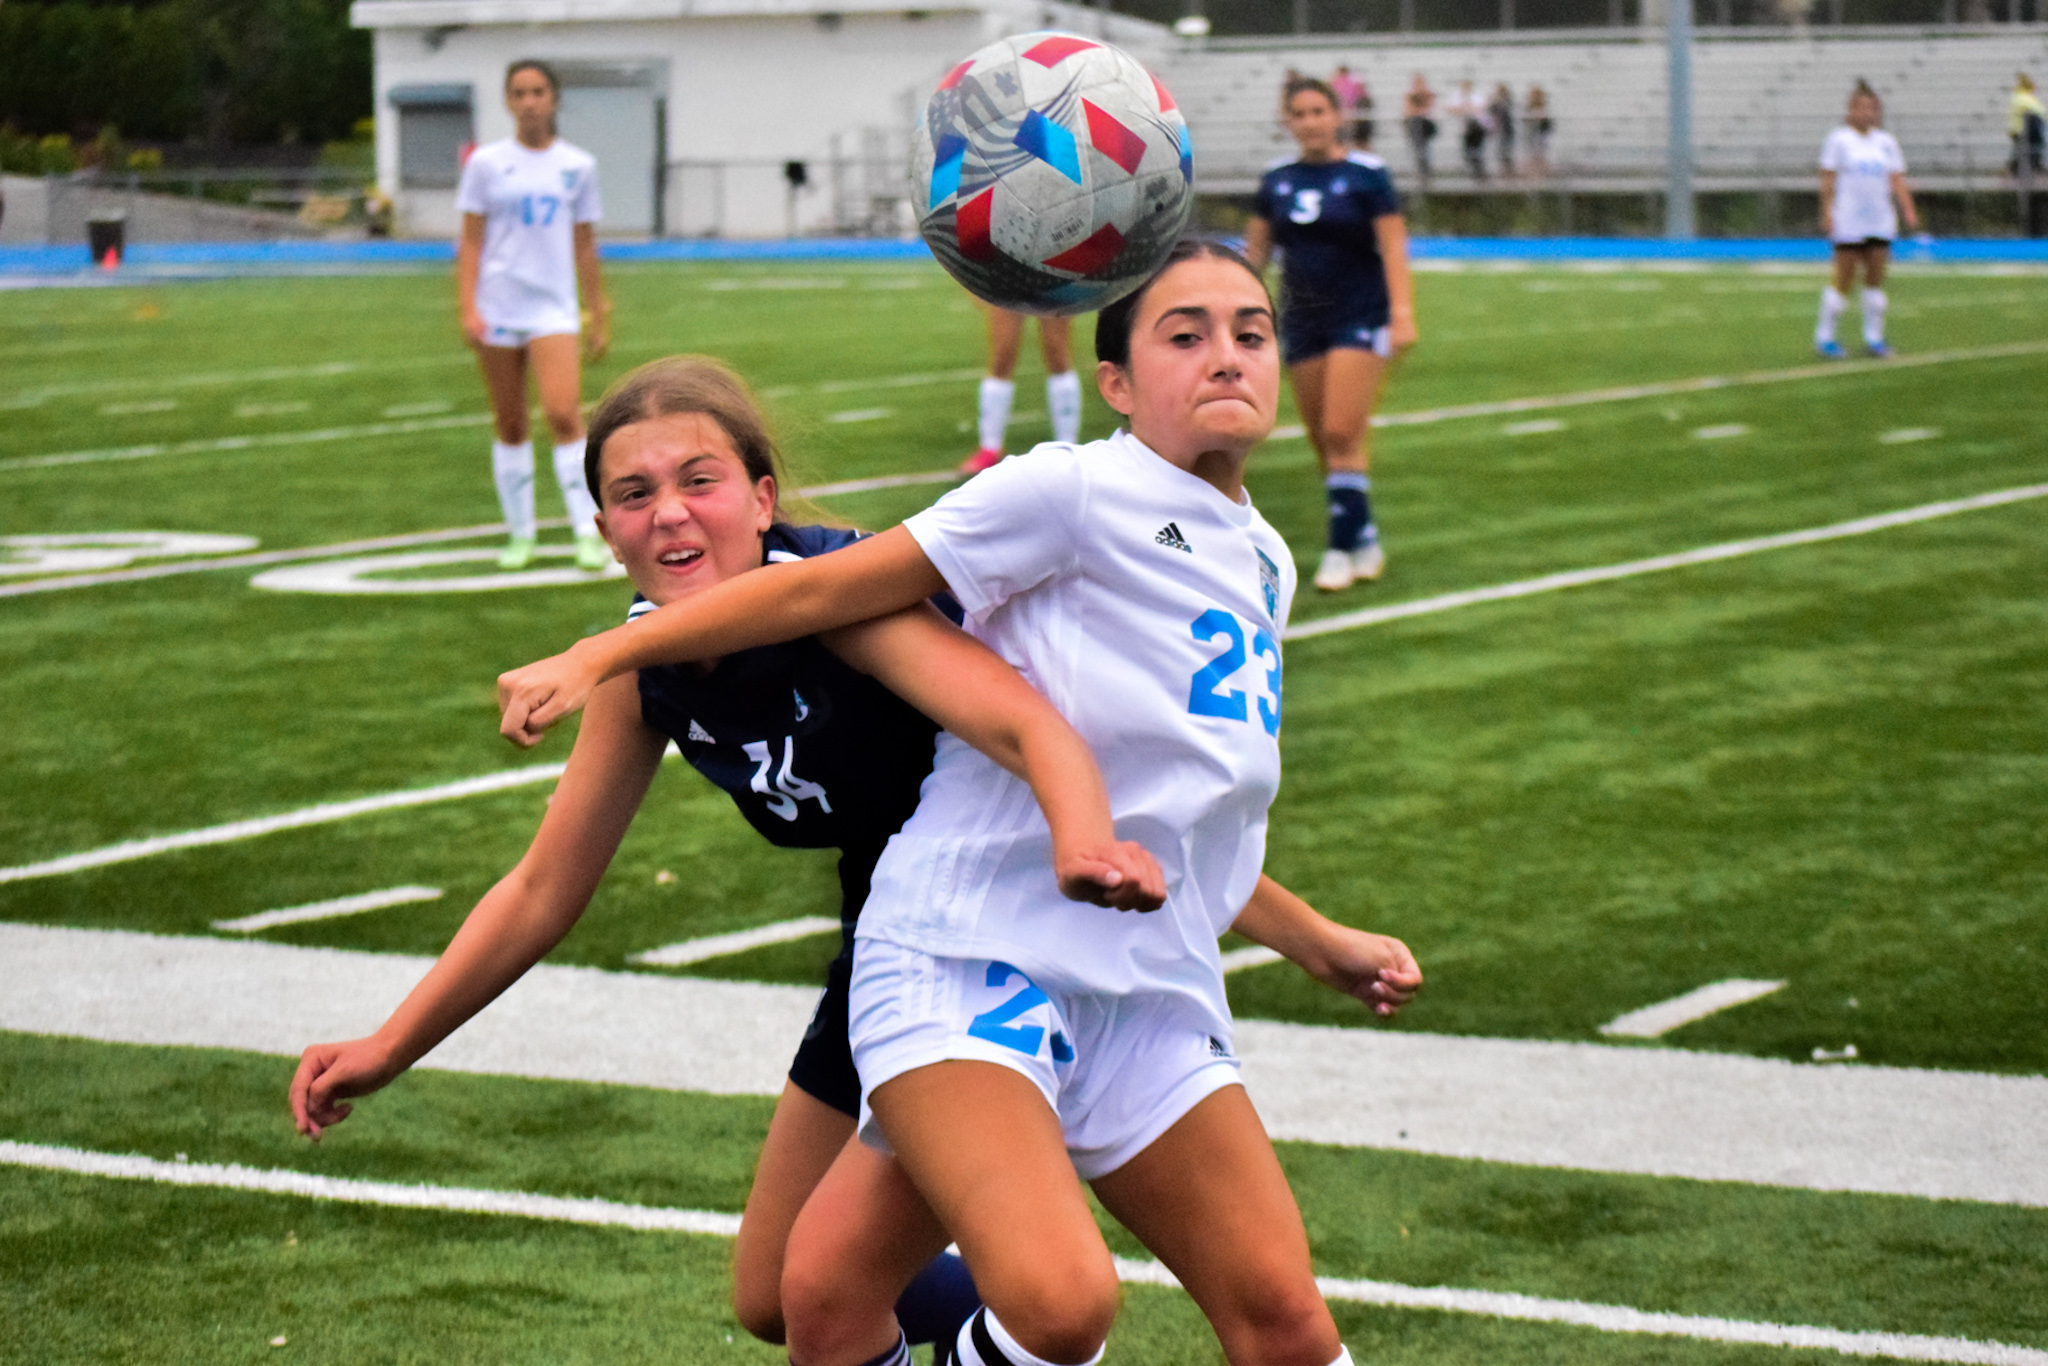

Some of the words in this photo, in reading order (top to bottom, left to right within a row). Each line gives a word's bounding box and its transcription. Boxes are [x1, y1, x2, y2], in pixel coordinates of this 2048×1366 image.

[520, 194, 560, 227] 17
[1188, 608, 1283, 738] 23
[741, 735, 834, 822] 34
